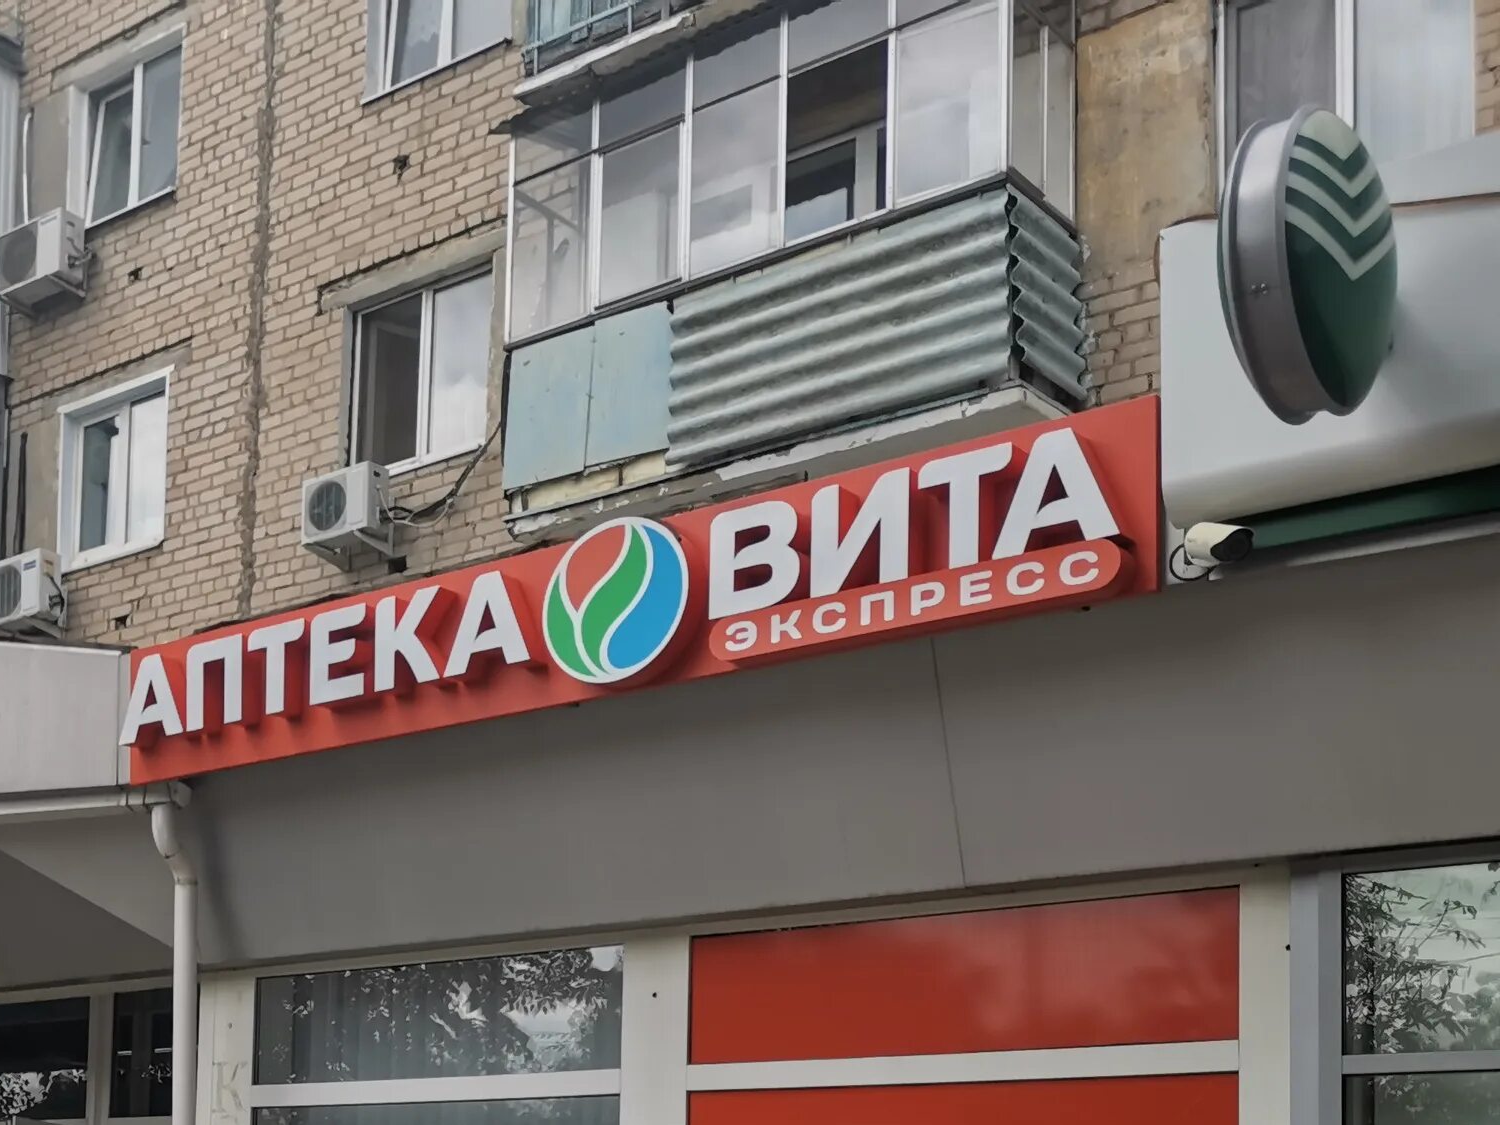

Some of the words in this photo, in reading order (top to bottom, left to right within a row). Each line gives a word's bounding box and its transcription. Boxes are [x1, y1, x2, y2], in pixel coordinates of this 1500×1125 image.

[119, 571, 530, 748] АПТЕКА
[707, 427, 1118, 619] ВИТА
[724, 549, 1100, 651] ЭКСПРЕСС
